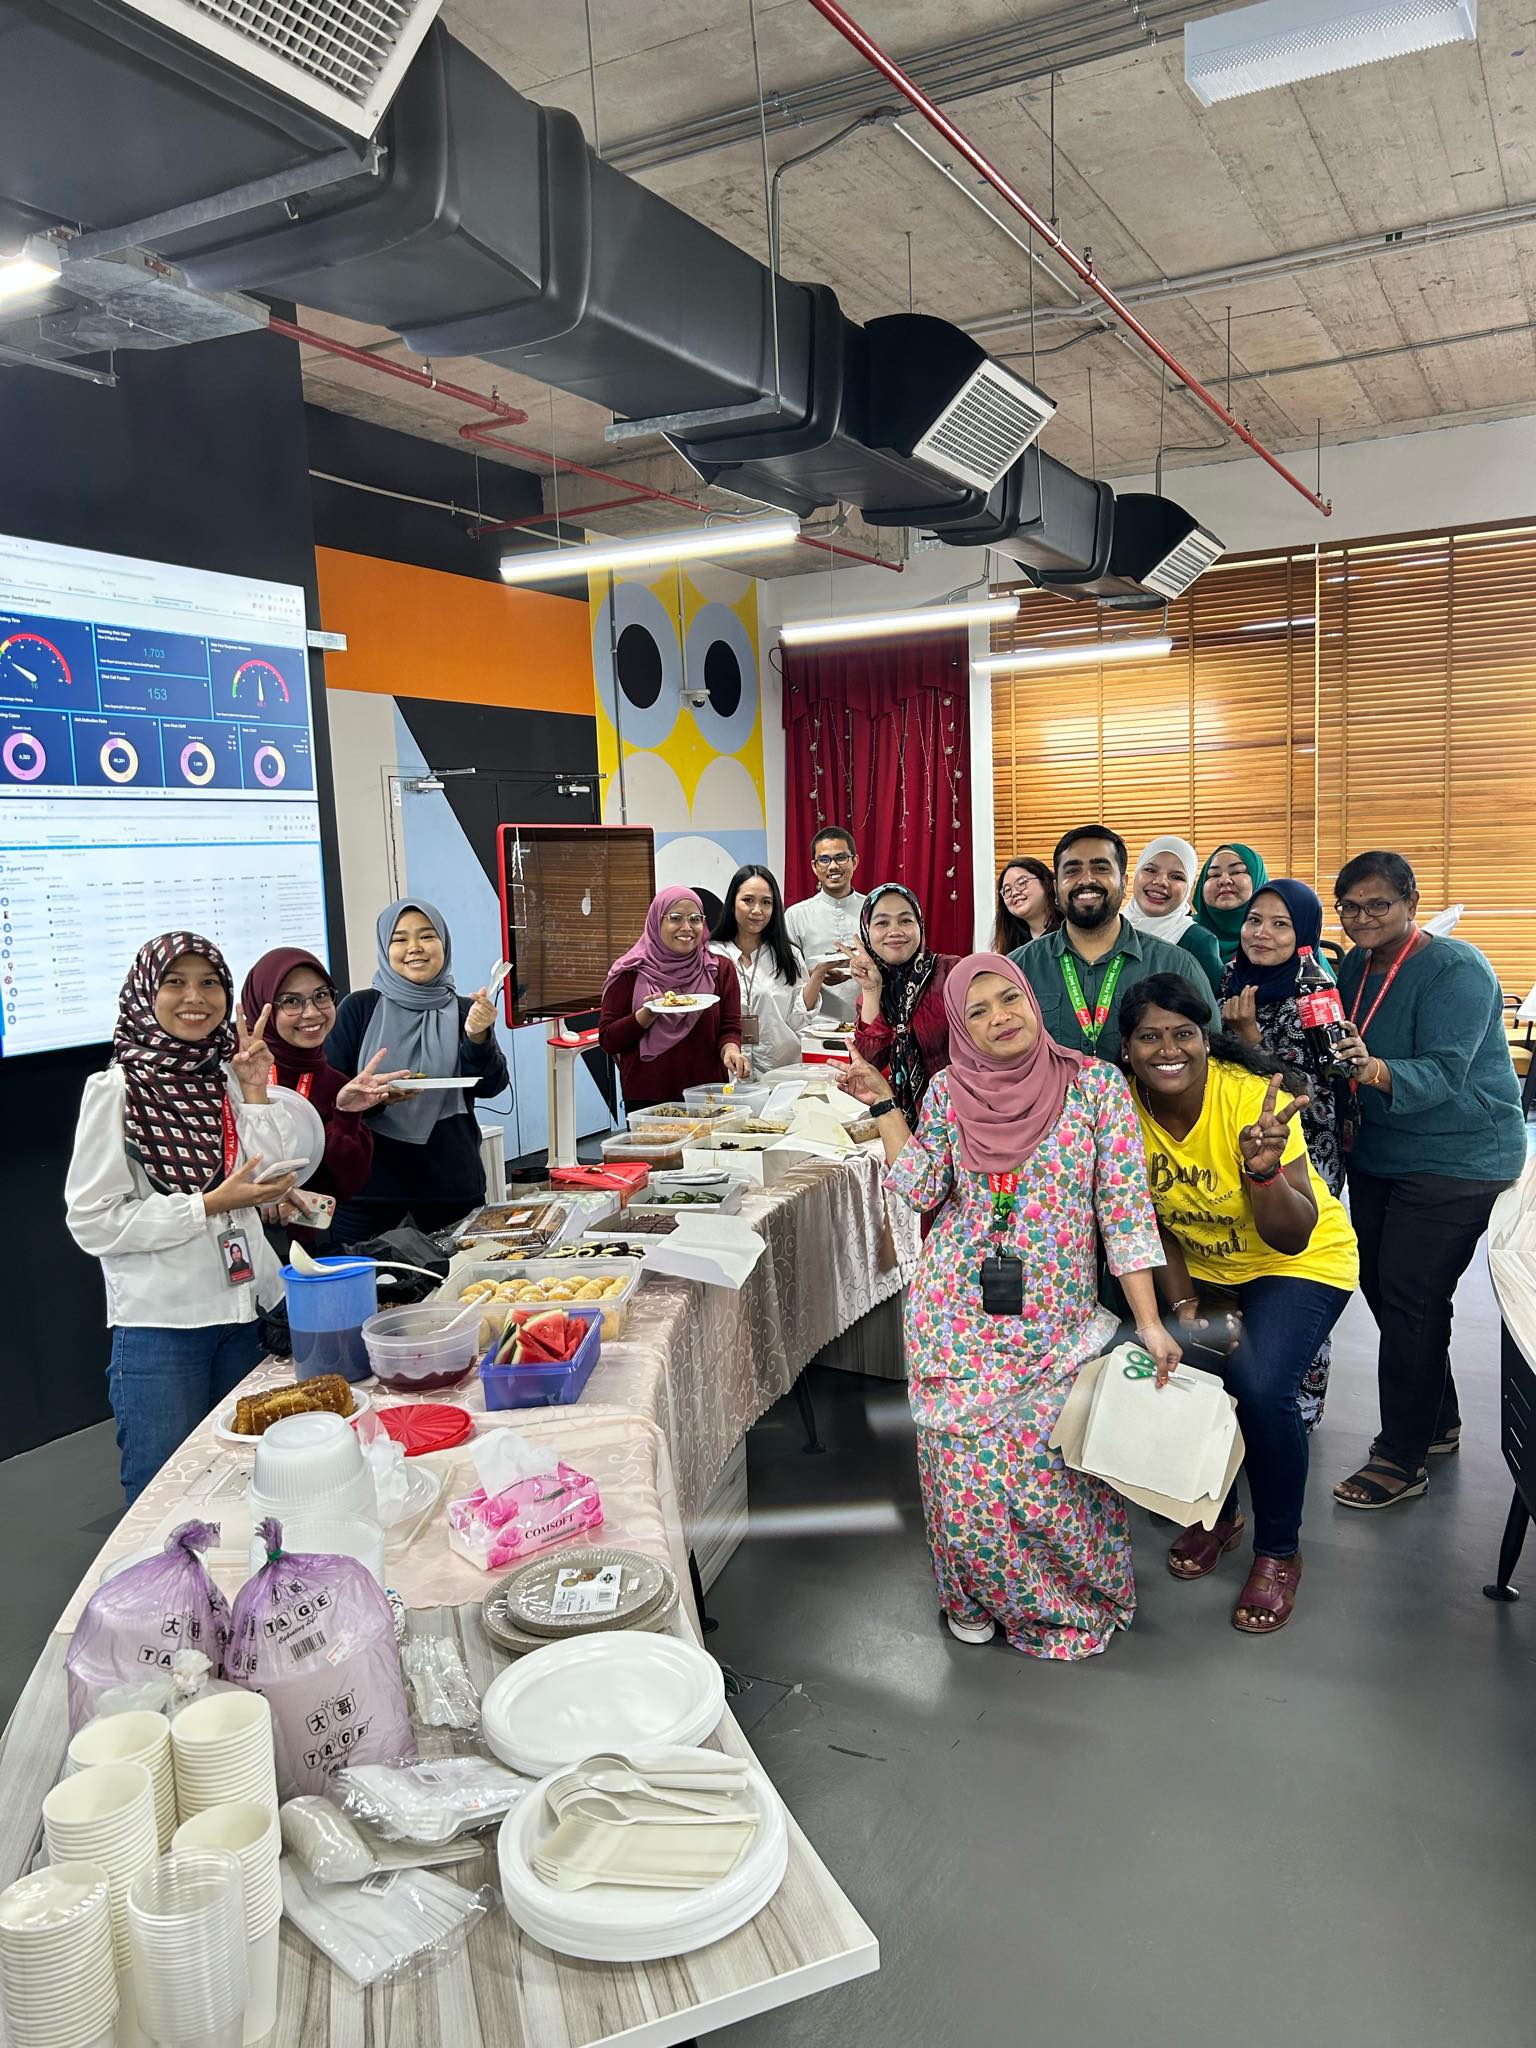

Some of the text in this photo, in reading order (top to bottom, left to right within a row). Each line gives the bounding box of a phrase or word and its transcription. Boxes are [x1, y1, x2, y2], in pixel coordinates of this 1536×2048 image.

[147, 688, 168, 701] 153
[524, 1513, 575, 1539] COMSOFT
[265, 1594, 328, 1634] TAGE
[310, 1696, 352, 1733] 大哥
